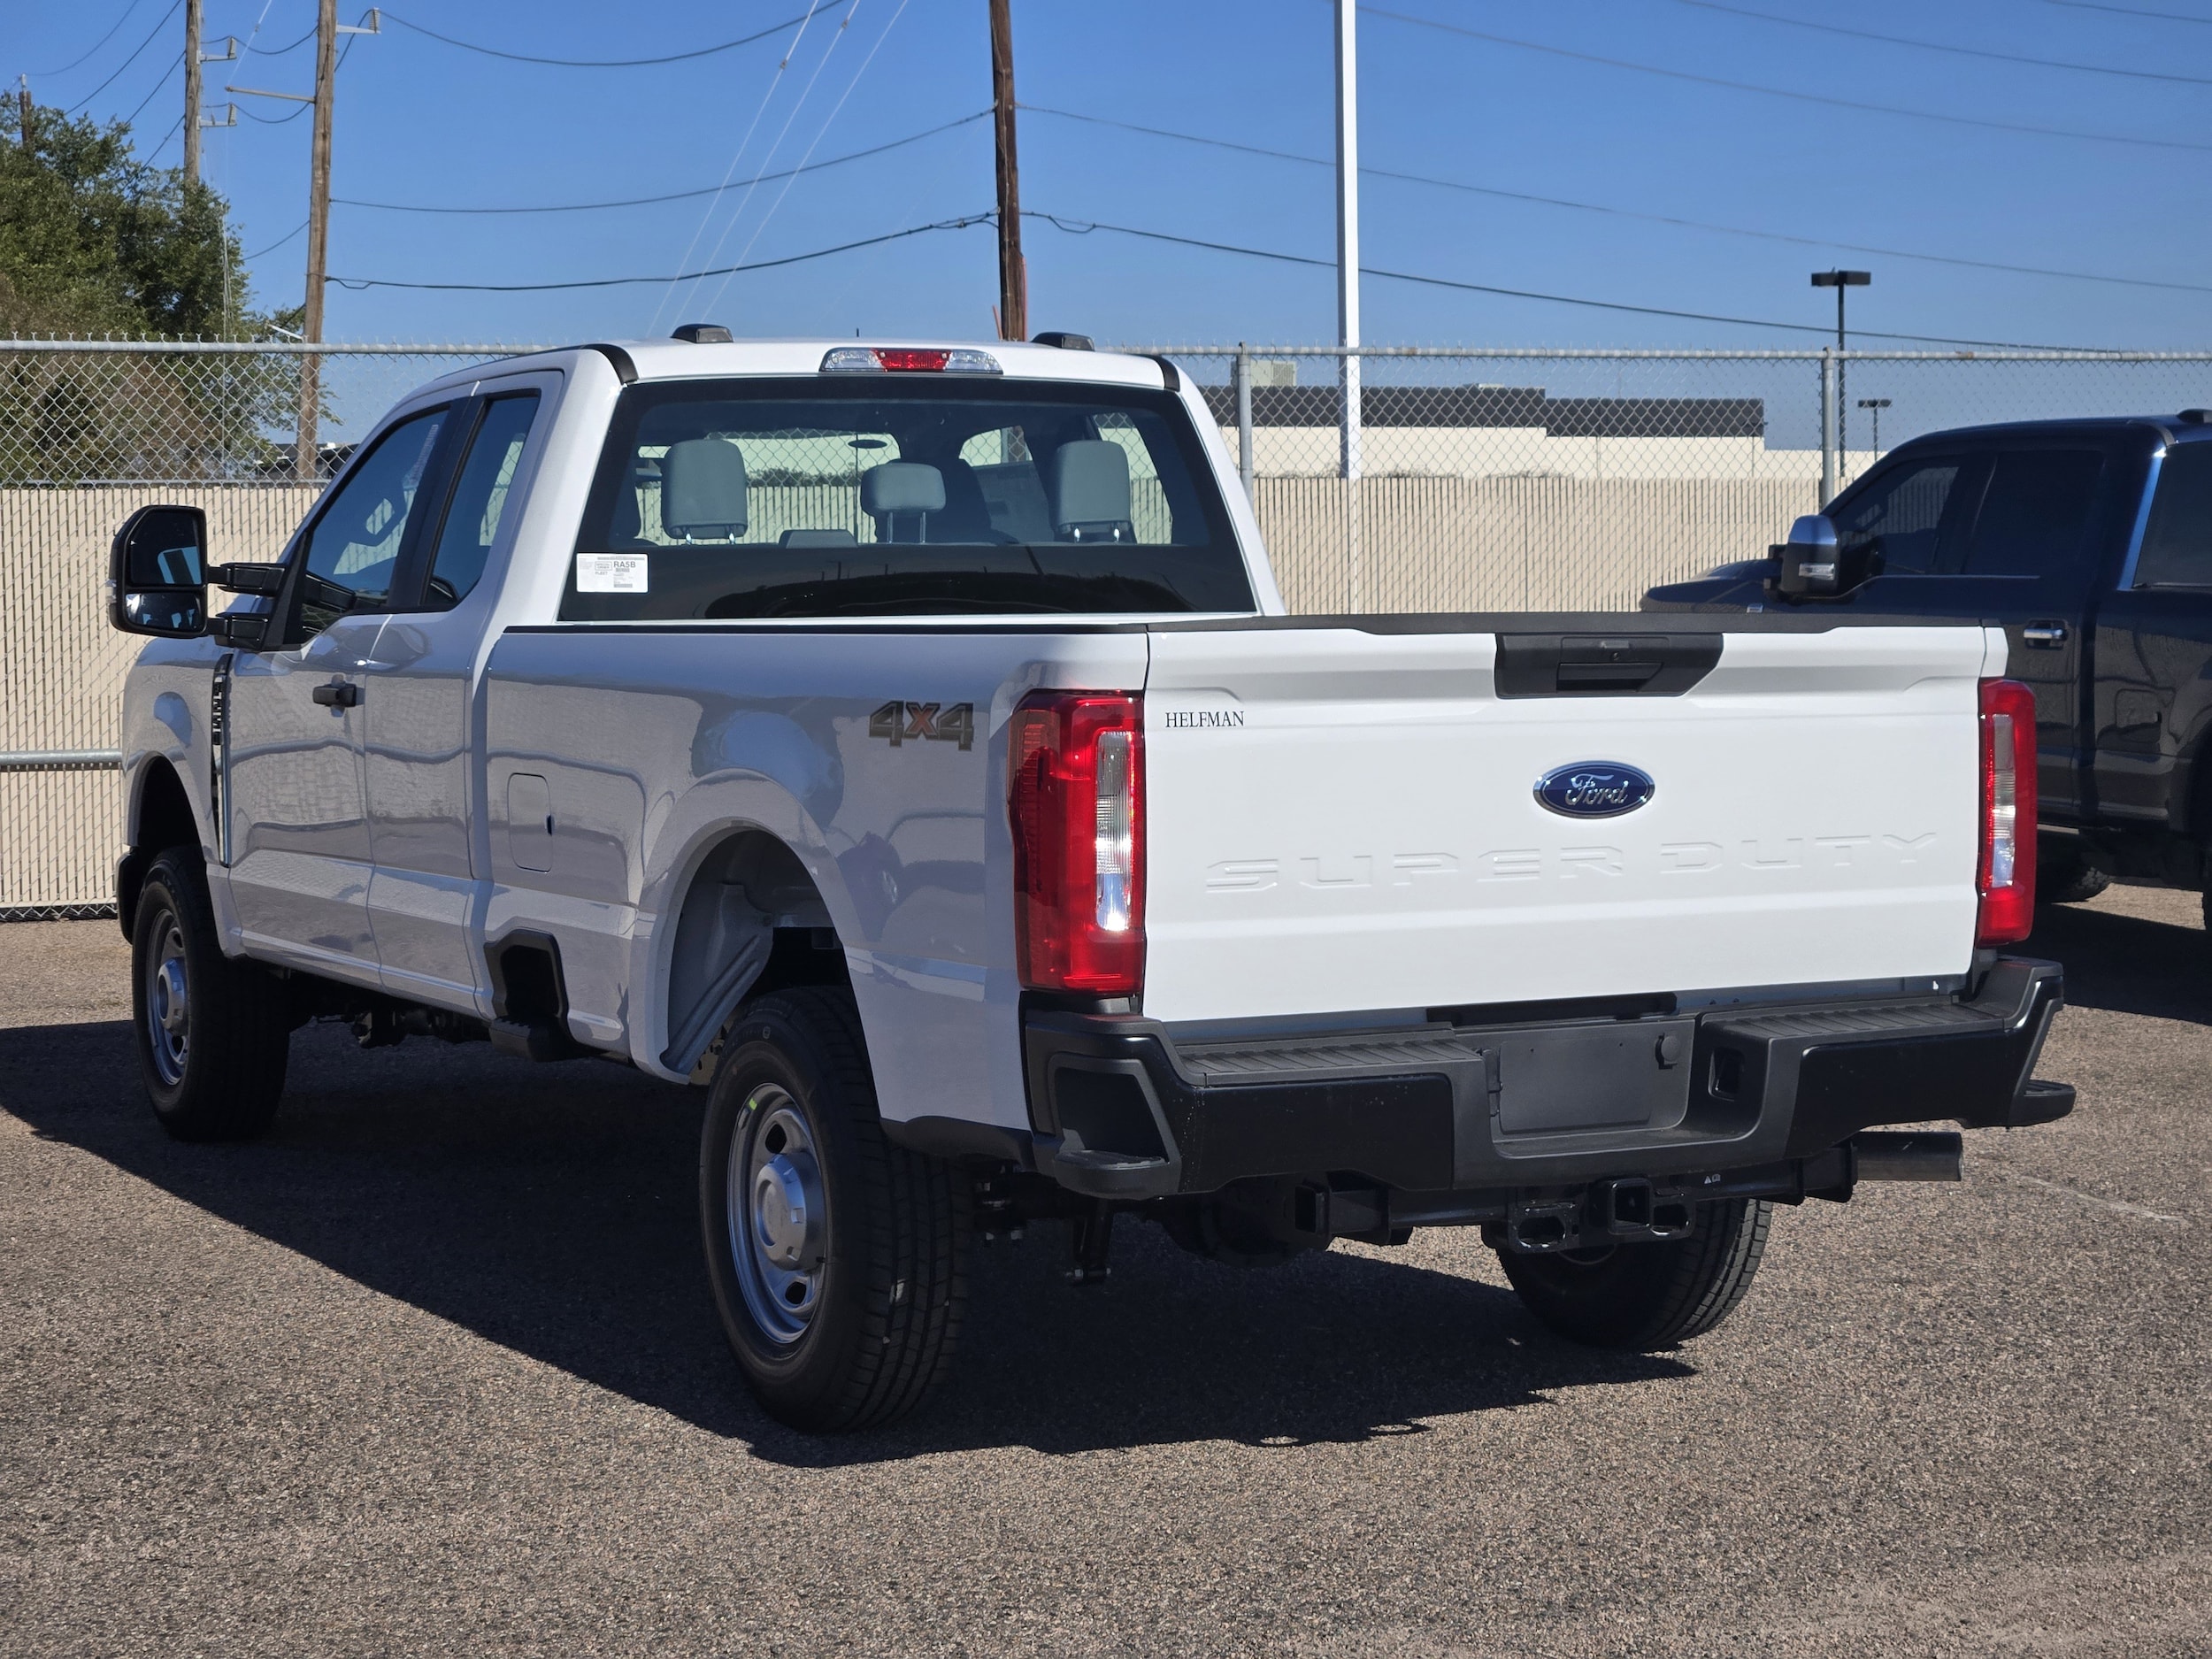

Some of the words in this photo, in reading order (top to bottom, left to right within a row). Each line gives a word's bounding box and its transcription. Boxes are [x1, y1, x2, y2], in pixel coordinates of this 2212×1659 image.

[1165, 710, 1244, 728] HELFMAN
[1564, 772, 1628, 806] Ford
[1206, 846, 1624, 894] SUPER
[1660, 832, 1937, 874] DUTY
